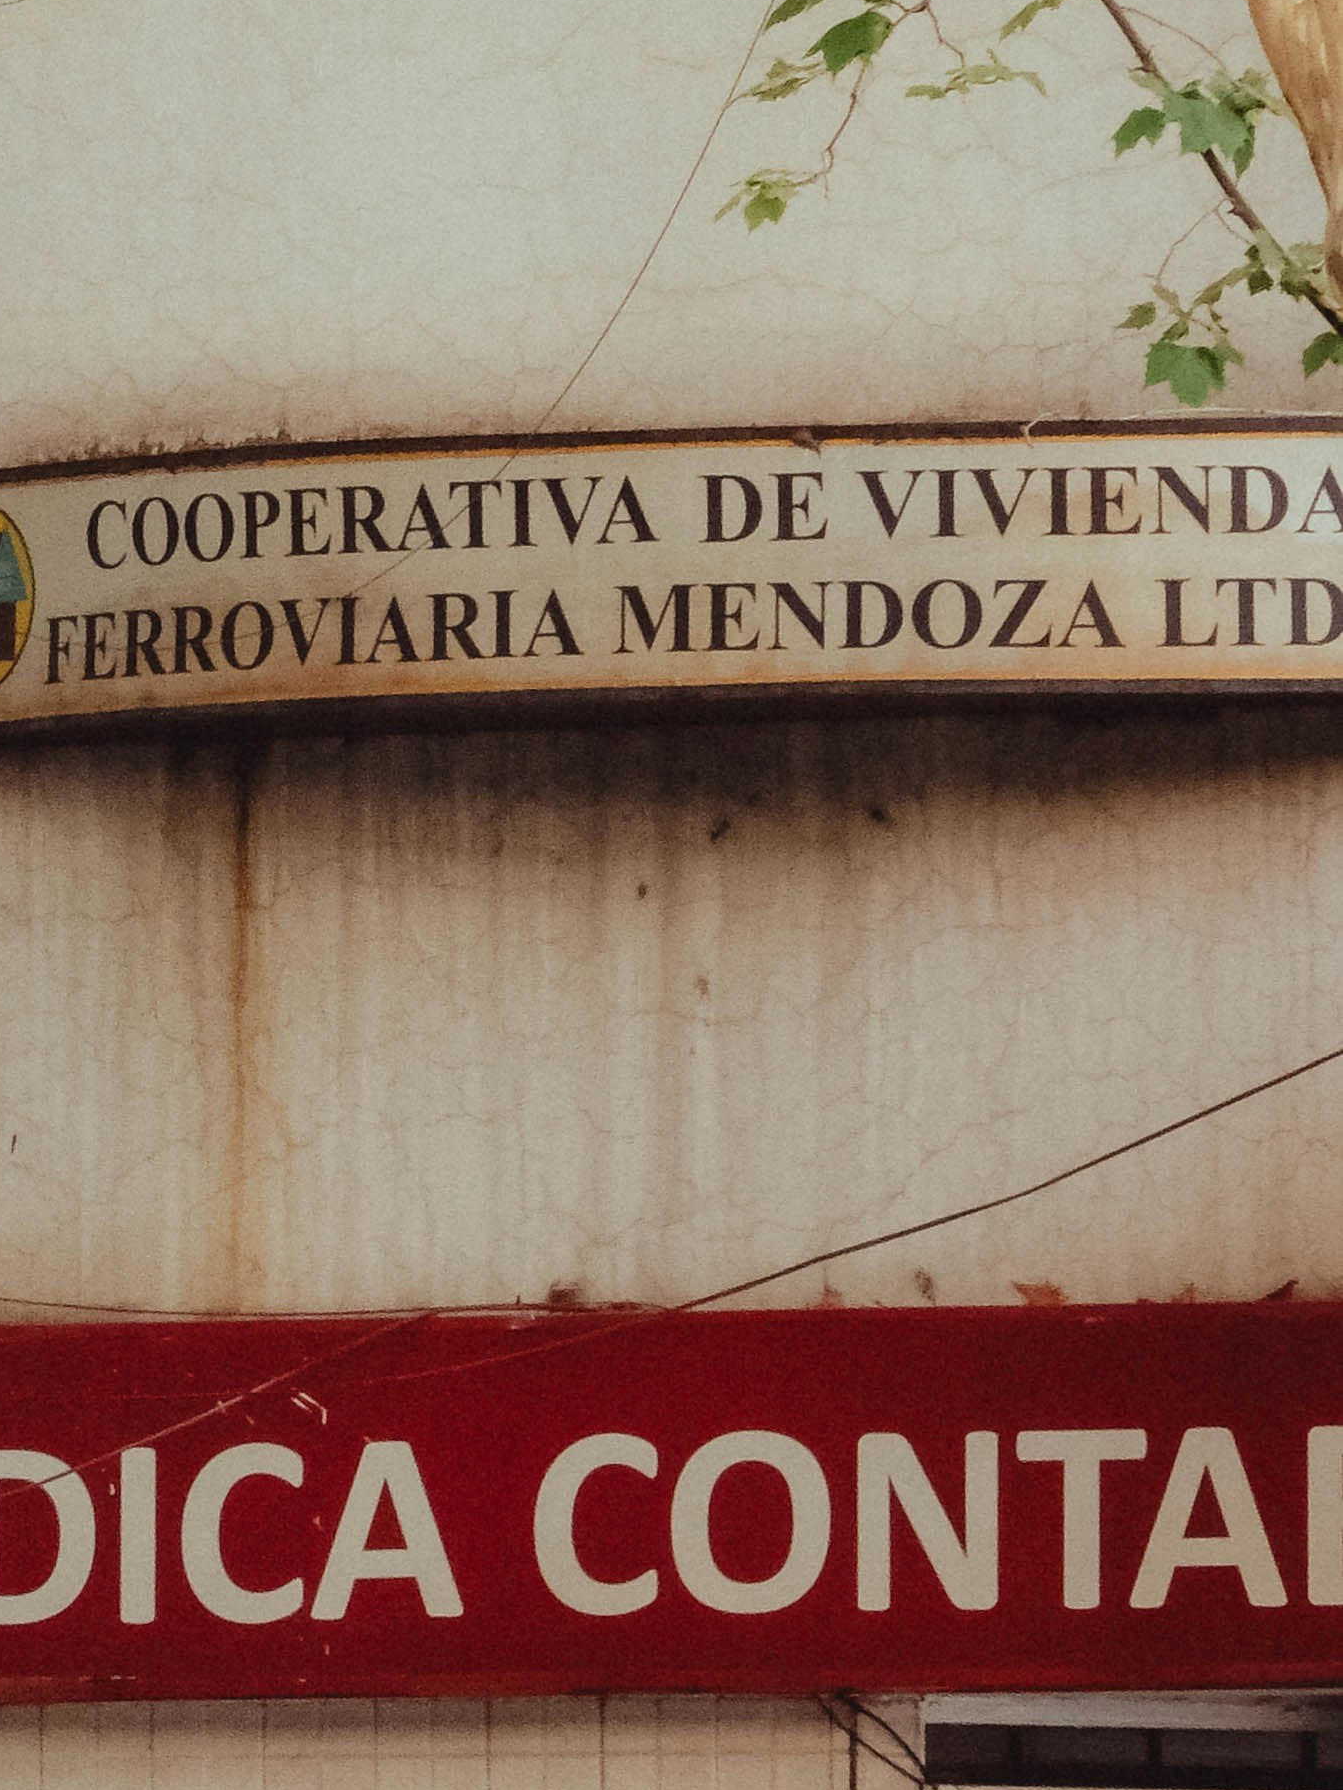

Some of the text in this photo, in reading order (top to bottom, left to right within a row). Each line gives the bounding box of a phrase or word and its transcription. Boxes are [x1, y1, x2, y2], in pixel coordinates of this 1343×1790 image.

[85, 464, 1343, 570] COOPERATIVA DE VIVIENDA
[42, 588, 585, 685] FERROVIARIA
[612, 577, 1127, 655] MENDOZA
